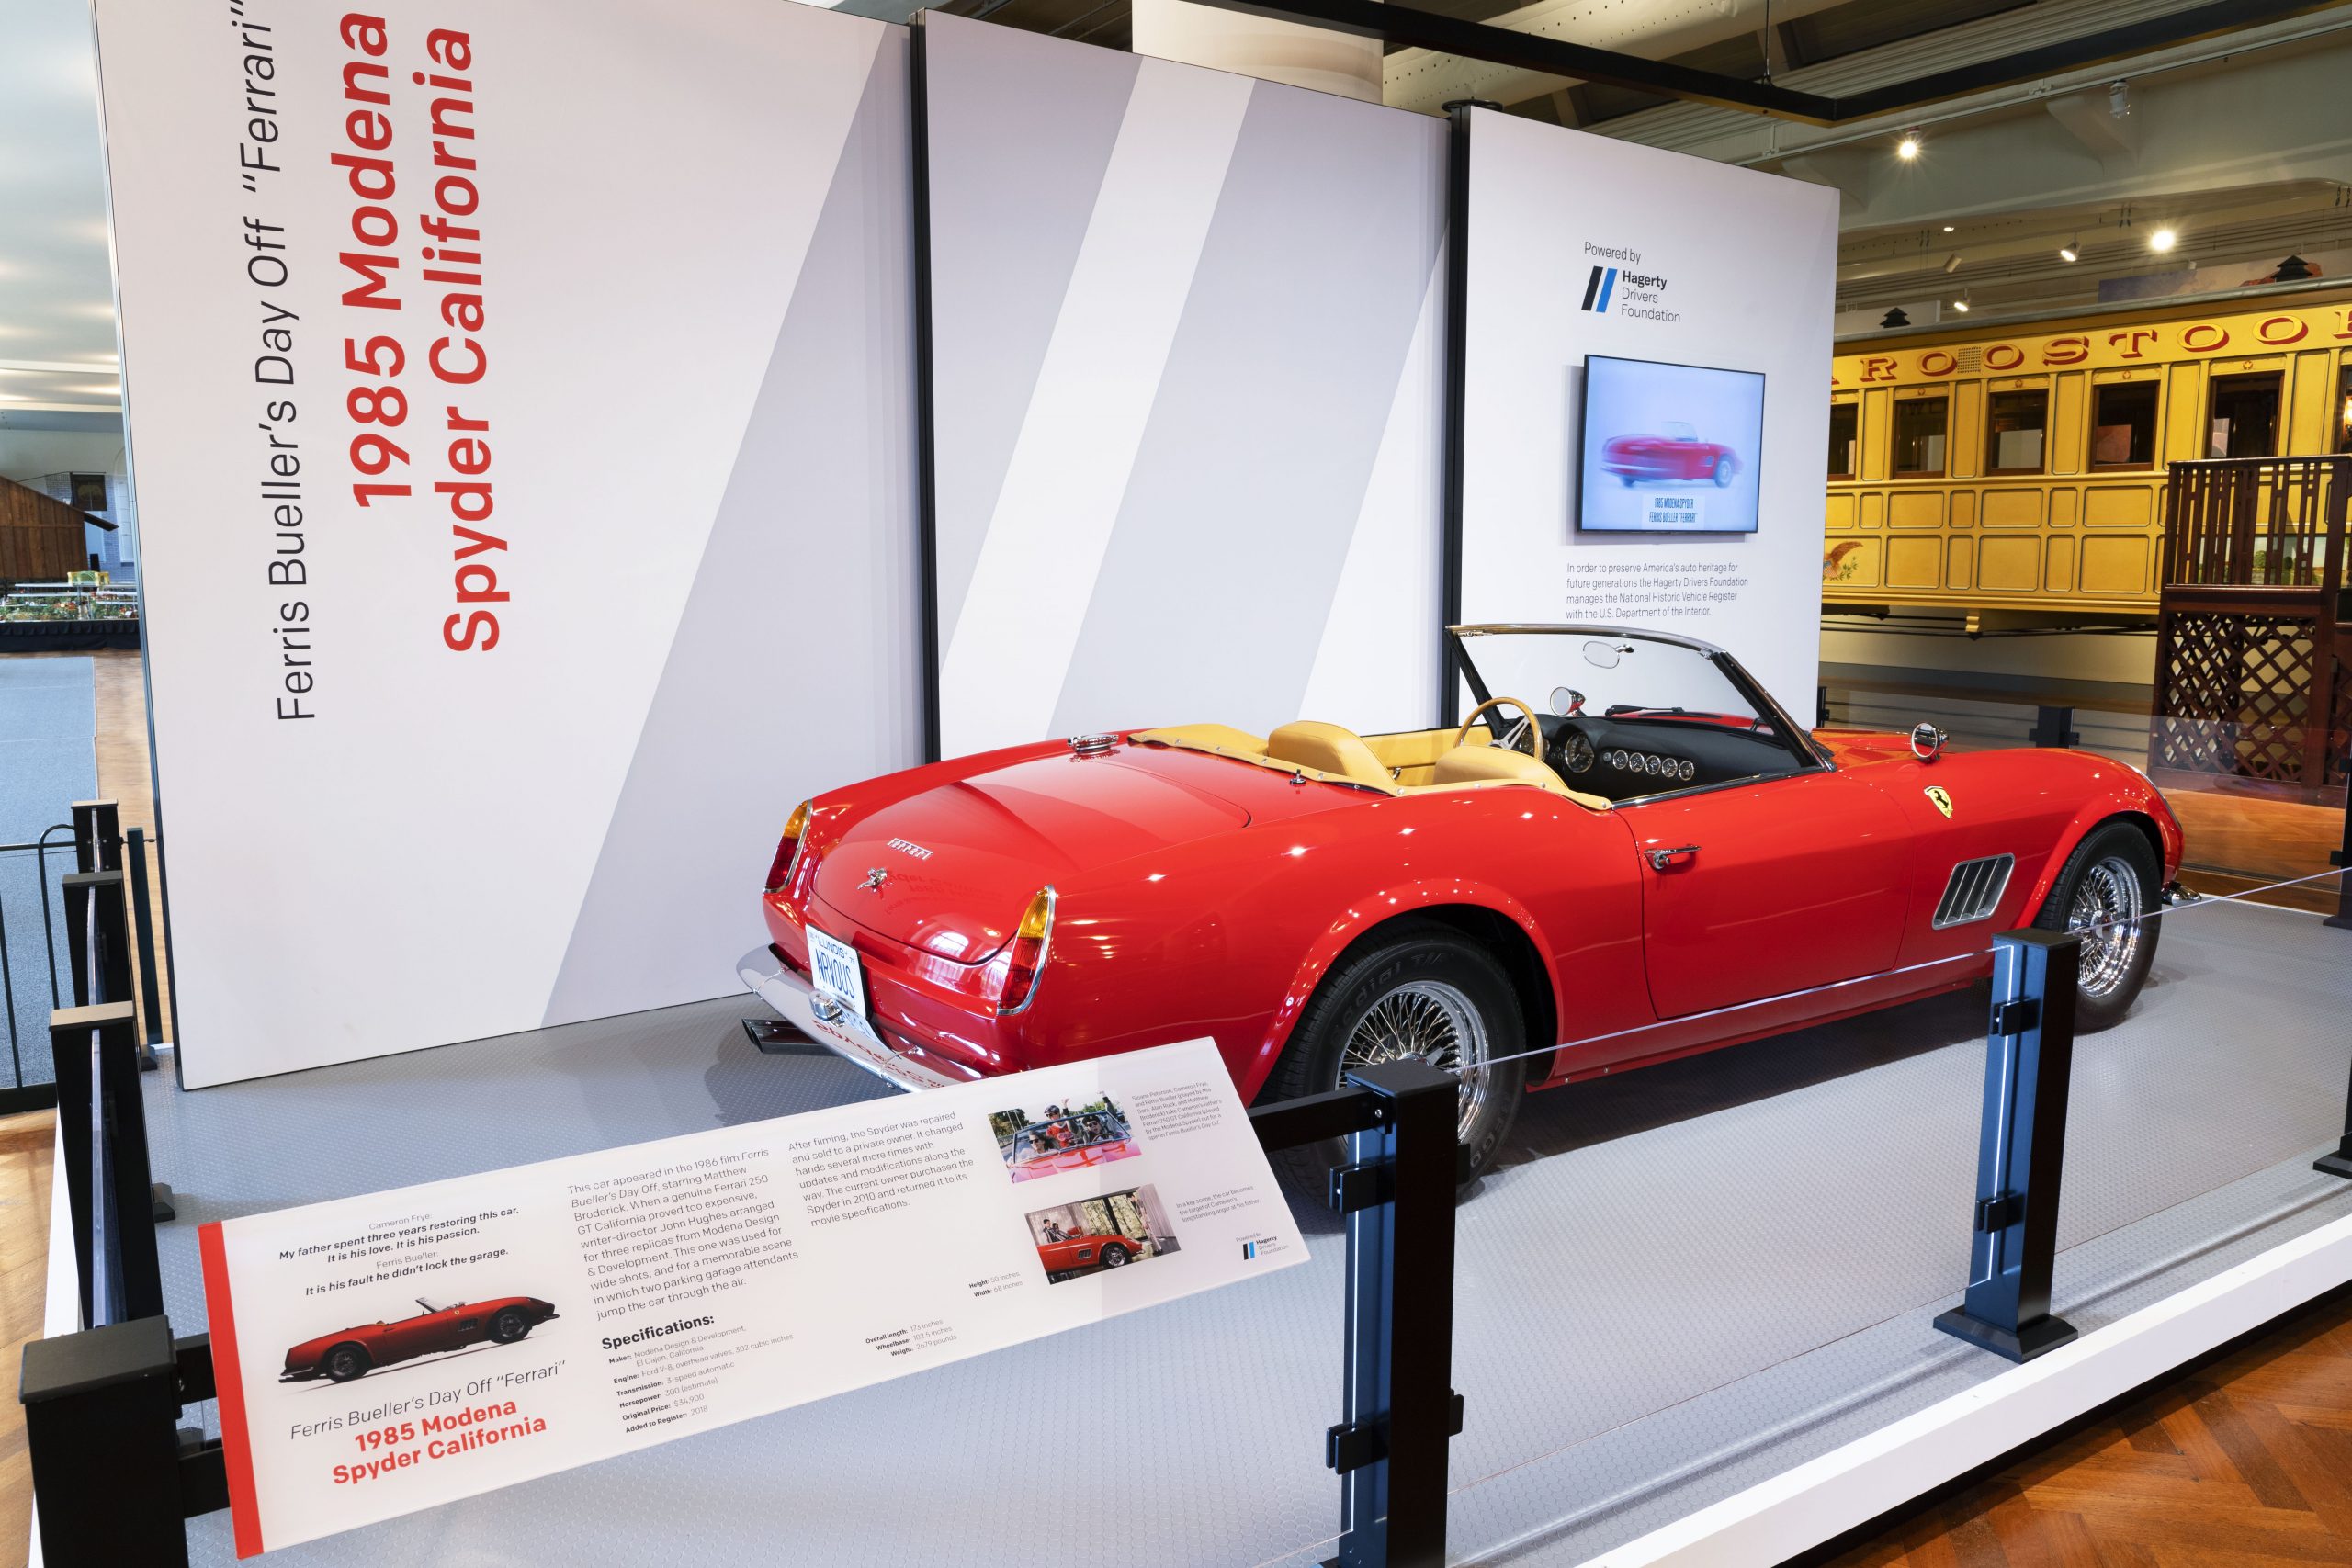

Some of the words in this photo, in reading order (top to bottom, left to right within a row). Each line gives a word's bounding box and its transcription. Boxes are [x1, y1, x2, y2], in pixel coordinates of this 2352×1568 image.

[331, 12, 402, 310] Modena
[413, 28, 487, 385] California
[243, 216, 288, 288] Off
[1585, 242, 1627, 260] Powered
[1630, 249, 1641, 265] by
[1623, 270, 1667, 290] Hagerty
[1623, 288, 1658, 303] Drivers
[1622, 304, 1680, 322] Foundation
[255, 301, 300, 384] Day
[345, 334, 412, 508] 1985
[258, 401, 308, 586] Bueller’s
[435, 405, 510, 652] Spyder
[1566, 579, 1591, 589] future
[1592, 579, 1638, 591] generations
[1639, 578, 1652, 588] the
[1653, 578, 1682, 590] Hagerty
[1683, 578, 1709, 587] Drivers
[1709, 577, 1749, 588] Foundation
[1567, 563, 1575, 573] In
[1577, 563, 1598, 573] order
[1599, 564, 1607, 573] to
[1608, 565, 1642, 575] preserve
[1643, 563, 1679, 573] America’s
[1680, 564, 1698, 573] auto
[1698, 562, 1728, 575] heritage
[1728, 562, 1739, 572] for
[1566, 596, 1604, 606] manages
[1605, 593, 1618, 604] the
[1619, 592, 1651, 603] National
[1652, 592, 1681, 603] Historic
[1682, 592, 1708, 602] Vehicle
[1708, 592, 1738, 604] Register
[1566, 610, 1583, 619] with
[1585, 609, 1598, 619] the
[1600, 608, 1614, 619] U.S.
[1616, 608, 1661, 620] Department
[1662, 606, 1670, 617] of
[1671, 607, 1684, 616] the
[1684, 606, 1712, 616] Interior.
[273, 601, 315, 720] Ferris
[815, 948, 855, 999] NRVOUS
[788, 1142, 811, 1151] After
[813, 1135, 849, 1146] filming,
[850, 1131, 866, 1139] the
[866, 1124, 899, 1136] Spyder
[900, 1121, 919, 1129] was
[920, 1111, 956, 1125] repaired
[792, 1153, 811, 1164] and
[812, 1149, 832, 1160] sold
[853, 1140, 885, 1153] private
[886, 1134, 916, 1145] owner.
[925, 1122, 964, 1137] changed
[567, 1185, 592, 1194] This
[593, 1181, 610, 1190] car
[613, 1169, 662, 1187] appeared
[675, 1165, 693, 1174] the
[695, 1158, 718, 1169] 1986
[720, 1156, 741, 1165] film
[741, 1150, 769, 1161] Ferris
[571, 1192, 617, 1209] Bueller’s
[619, 1190, 639, 1199] Day
[641, 1183, 661, 1194] Off,
[662, 1177, 703, 1190] starring
[704, 1168, 747, 1181] Matthew
[574, 1204, 628, 1222] Broderick.
[629, 1199, 661, 1210] When
[672, 1188, 713, 1203] genuine
[714, 1181, 747, 1193] Ferrari
[748, 1175, 769, 1186] 250
[279, 1251, 295, 1260] My
[298, 1245, 332, 1257] father
[334, 1237, 366, 1250] spent
[368, 1232, 396, 1243] three
[398, 1226, 427, 1238] years
[429, 1216, 477, 1231] restoring
[479, 1212, 498, 1221] this
[501, 1208, 519, 1216] car.
[368, 1218, 410, 1231] Cameron
[411, 1214, 433, 1223] Frye:
[328, 1255, 335, 1263] It
[338, 1253, 348, 1261] is
[350, 1249, 367, 1258] his
[369, 1246, 394, 1255] love.
[407, 1239, 416, 1247] is
[418, 1235, 435, 1246] his
[436, 1228, 480, 1244] passion.
[376, 1258, 403, 1269] Ferris
[404, 1252, 438, 1263] Bueller:
[306, 1288, 314, 1296] It
[317, 1285, 326, 1293] is
[329, 1281, 345, 1292] his
[348, 1275, 374, 1287] fault
[376, 1273, 390, 1281] he
[392, 1265, 424, 1278] didn’t
[425, 1260, 447, 1271] lock
[450, 1258, 468, 1266] the
[469, 1249, 508, 1264] garage.
[602, 1316, 715, 1350] Specifications:
[608, 1356, 632, 1364] Maker:
[634, 1348, 664, 1358] Modena
[664, 1340, 690, 1351] Design
[291, 1417, 343, 1440] Ferris
[348, 1397, 424, 1427] Bueller’s
[429, 1389, 462, 1406] Day
[467, 1378, 492, 1396] Off
[497, 1360, 566, 1387] “Ferrari”
[616, 1382, 664, 1396] Transmission:
[619, 1394, 662, 1408] Horsepower:
[355, 1422, 416, 1452] 1985
[421, 1402, 517, 1437] Modena
[622, 1409, 650, 1421] Original
[333, 1450, 422, 1484] Spyder
[427, 1417, 547, 1460] California
